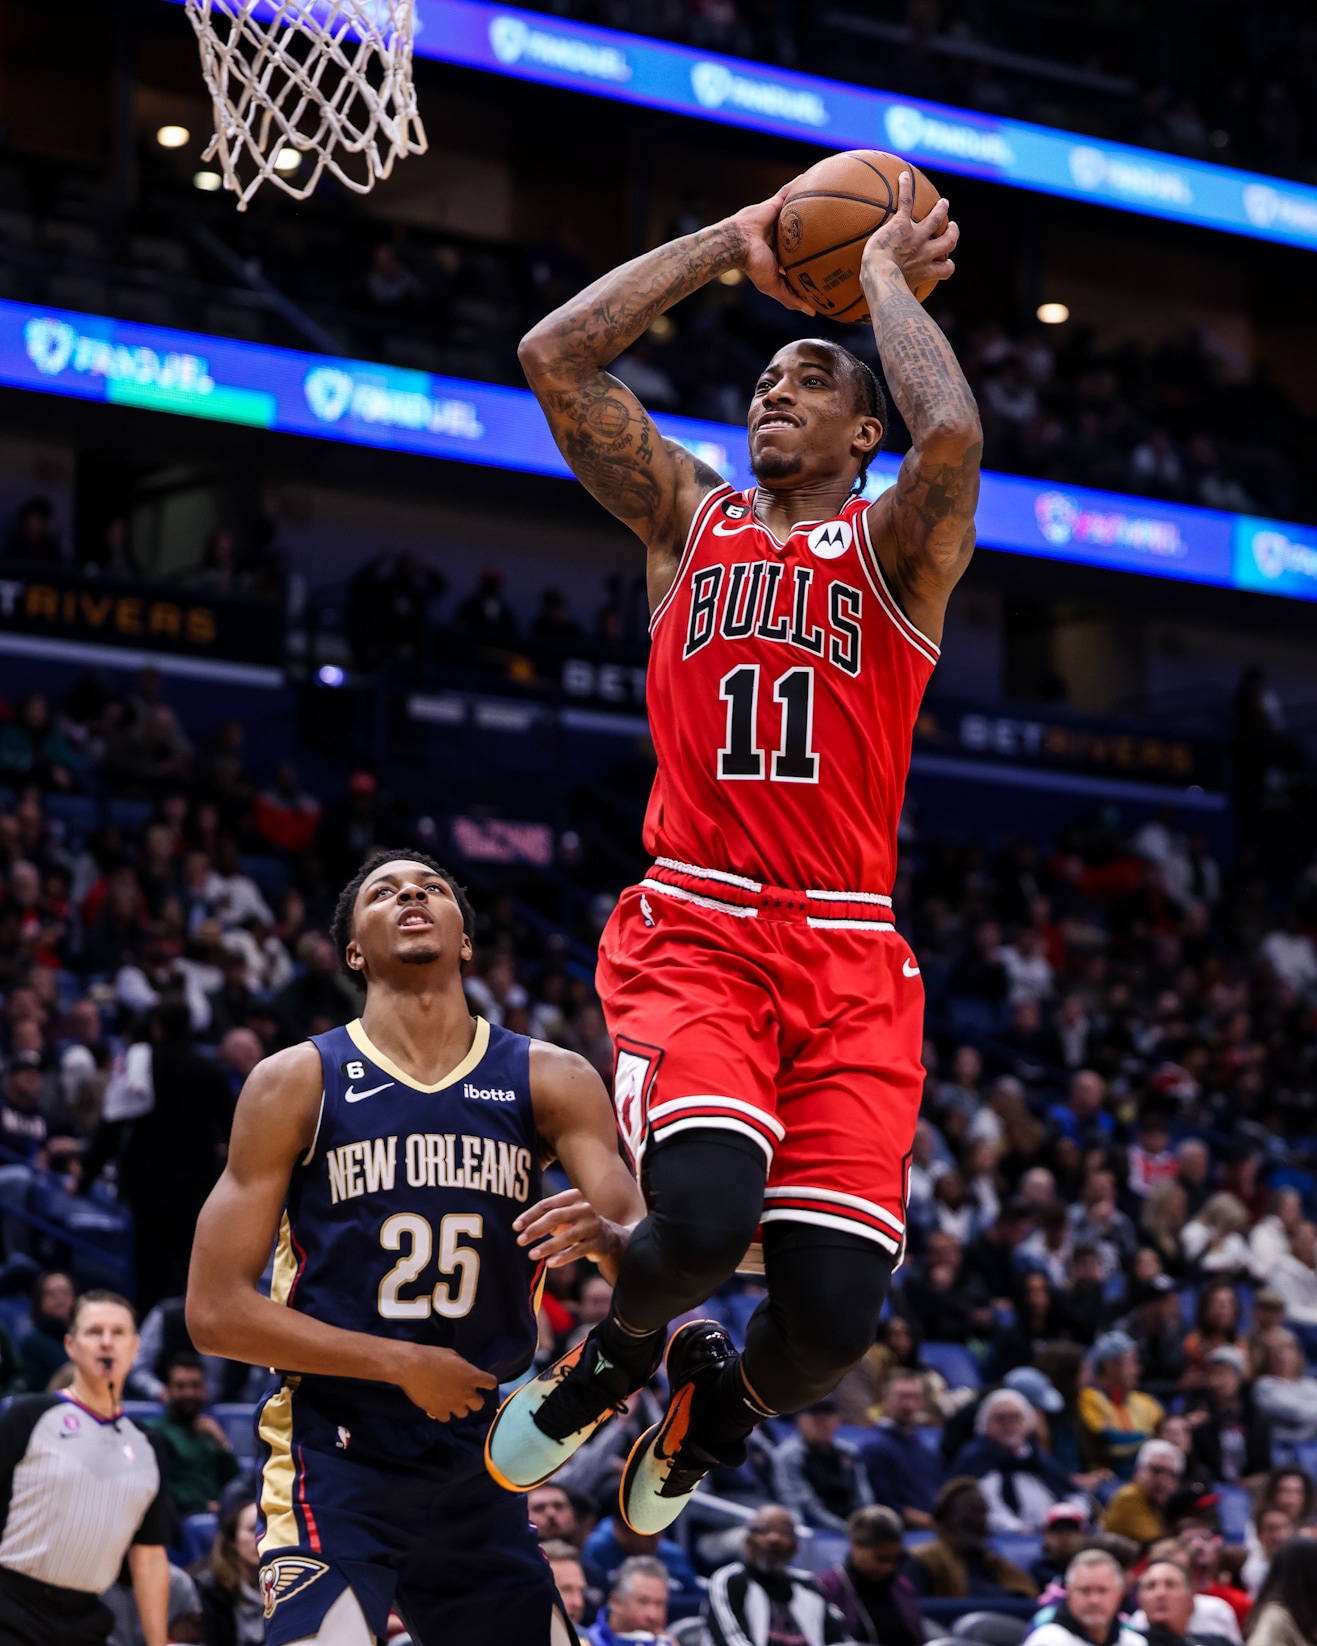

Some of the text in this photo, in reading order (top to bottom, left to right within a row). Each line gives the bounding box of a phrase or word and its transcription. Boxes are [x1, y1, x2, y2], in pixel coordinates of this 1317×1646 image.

[725, 505, 744, 519] 6
[682, 560, 863, 679] BULLS
[716, 663, 820, 785] 11
[346, 1061, 366, 1080] 6
[463, 1083, 516, 1102] ibotta
[326, 1133, 532, 1205] NEW ORLEANS
[378, 1212, 484, 1320] 25
